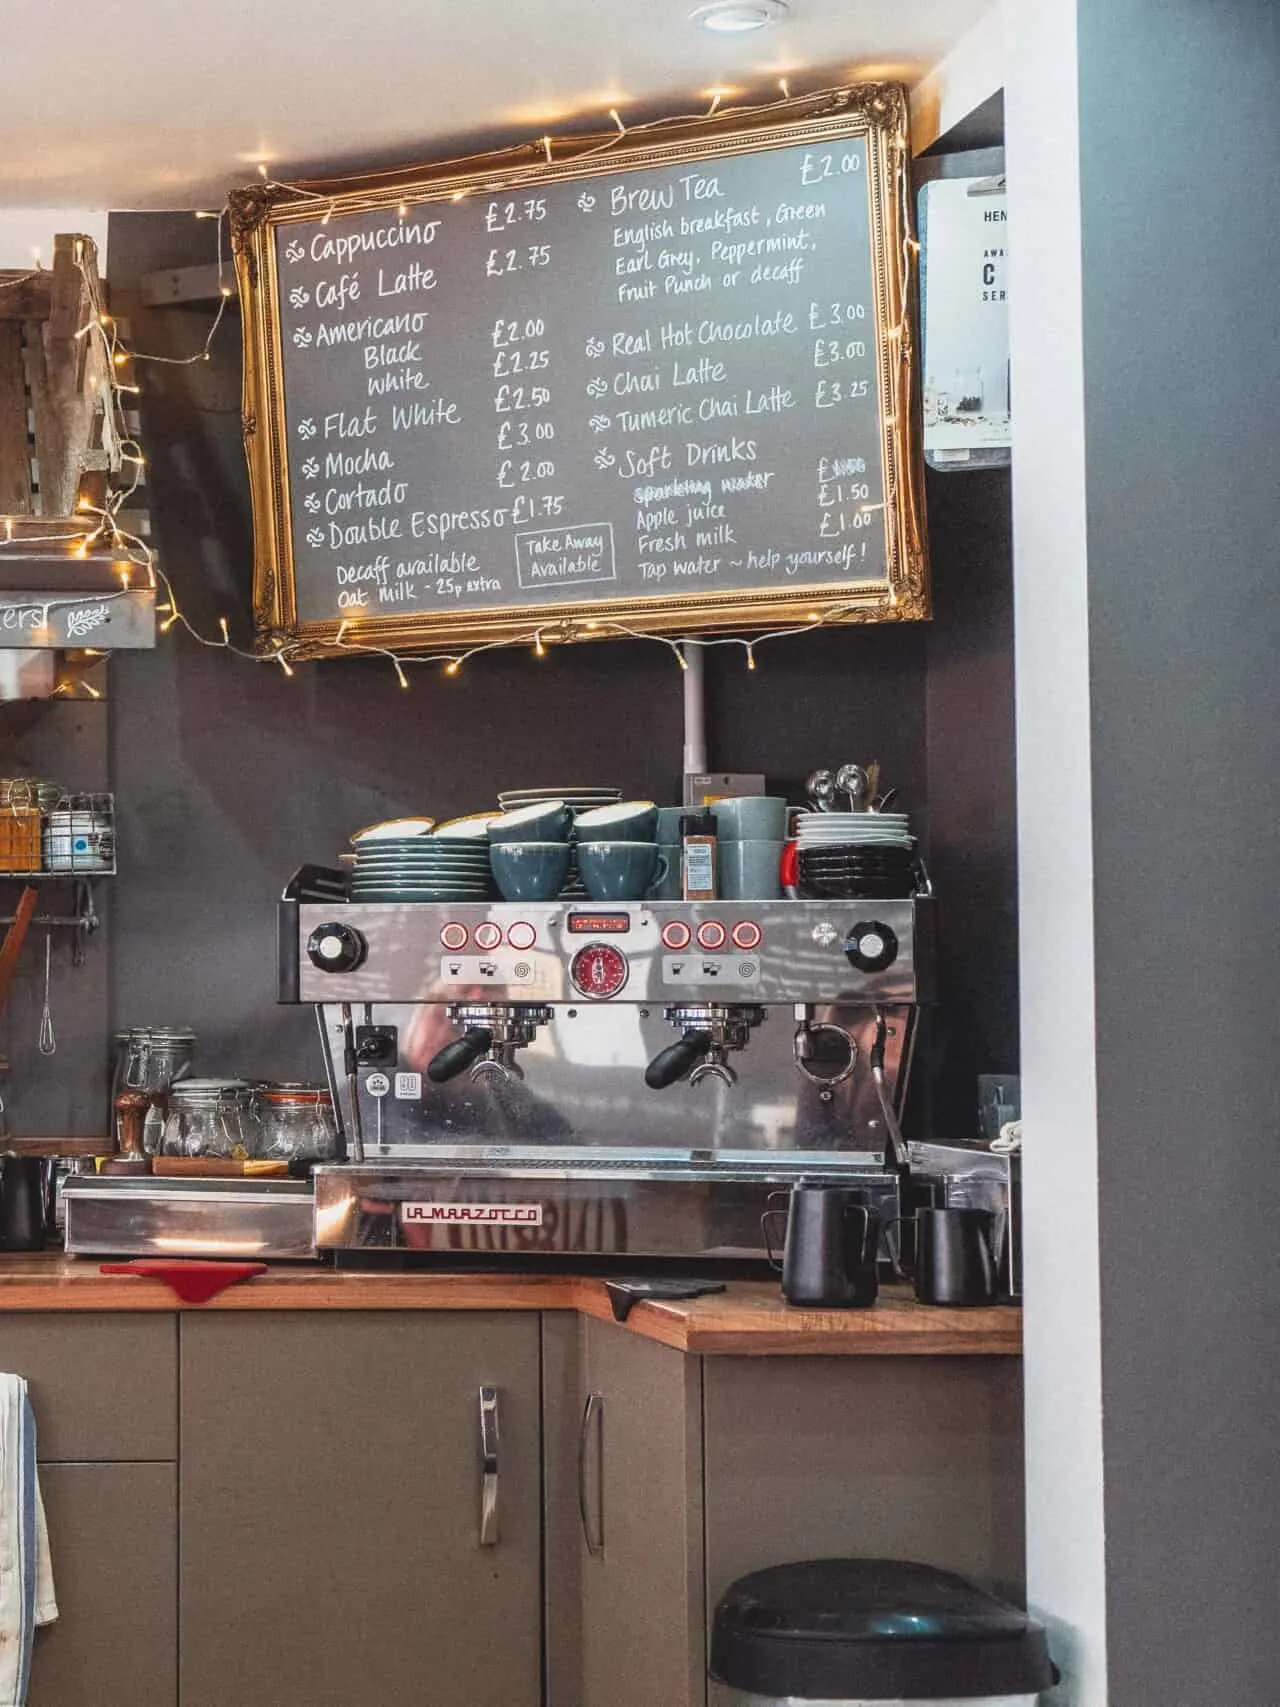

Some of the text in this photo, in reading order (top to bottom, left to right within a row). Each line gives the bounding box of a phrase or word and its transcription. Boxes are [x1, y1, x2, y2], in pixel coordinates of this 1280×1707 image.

[611, 153, 860, 215] Brew Tea £2.00
[310, 200, 547, 264] Cappuccino £2.75
[613, 222, 674, 252] English
[775, 200, 826, 222] Green
[316, 245, 552, 310] Café Latte £2.75
[616, 253, 652, 276] Earl
[618, 258, 804, 302] Fruit Punch or decaff
[316, 312, 429, 347] Americano
[364, 319, 545, 369] Black £2.00
[612, 302, 865, 357] Real Hot Chocolate £3.00
[493, 350, 550, 377] £2.25
[613, 339, 866, 396] Chai Latte £3.00
[324, 385, 551, 439] Flat White £2.50
[616, 380, 869, 433] Tumeric Chai Latte £3.25
[325, 421, 554, 479] Mocha £3.00
[618, 437, 757, 478] Soft Drinks
[324, 460, 555, 515] Cortado £2.00
[636, 484, 869, 533] Apple juice £1.50
[329, 495, 565, 550] Double Espresso £1.75
[526, 533, 603, 558] Take Away
[638, 512, 872, 555] Fresh milk £1.00
[336, 551, 480, 585] Decaff available
[531, 557, 602, 578] Available
[638, 561, 666, 579] Tap
[673, 554, 720, 575] water
[747, 549, 780, 573] help
[337, 591, 368, 609] Oat
[435, 578, 462, 597] 25p
[466, 578, 502, 592] extra
